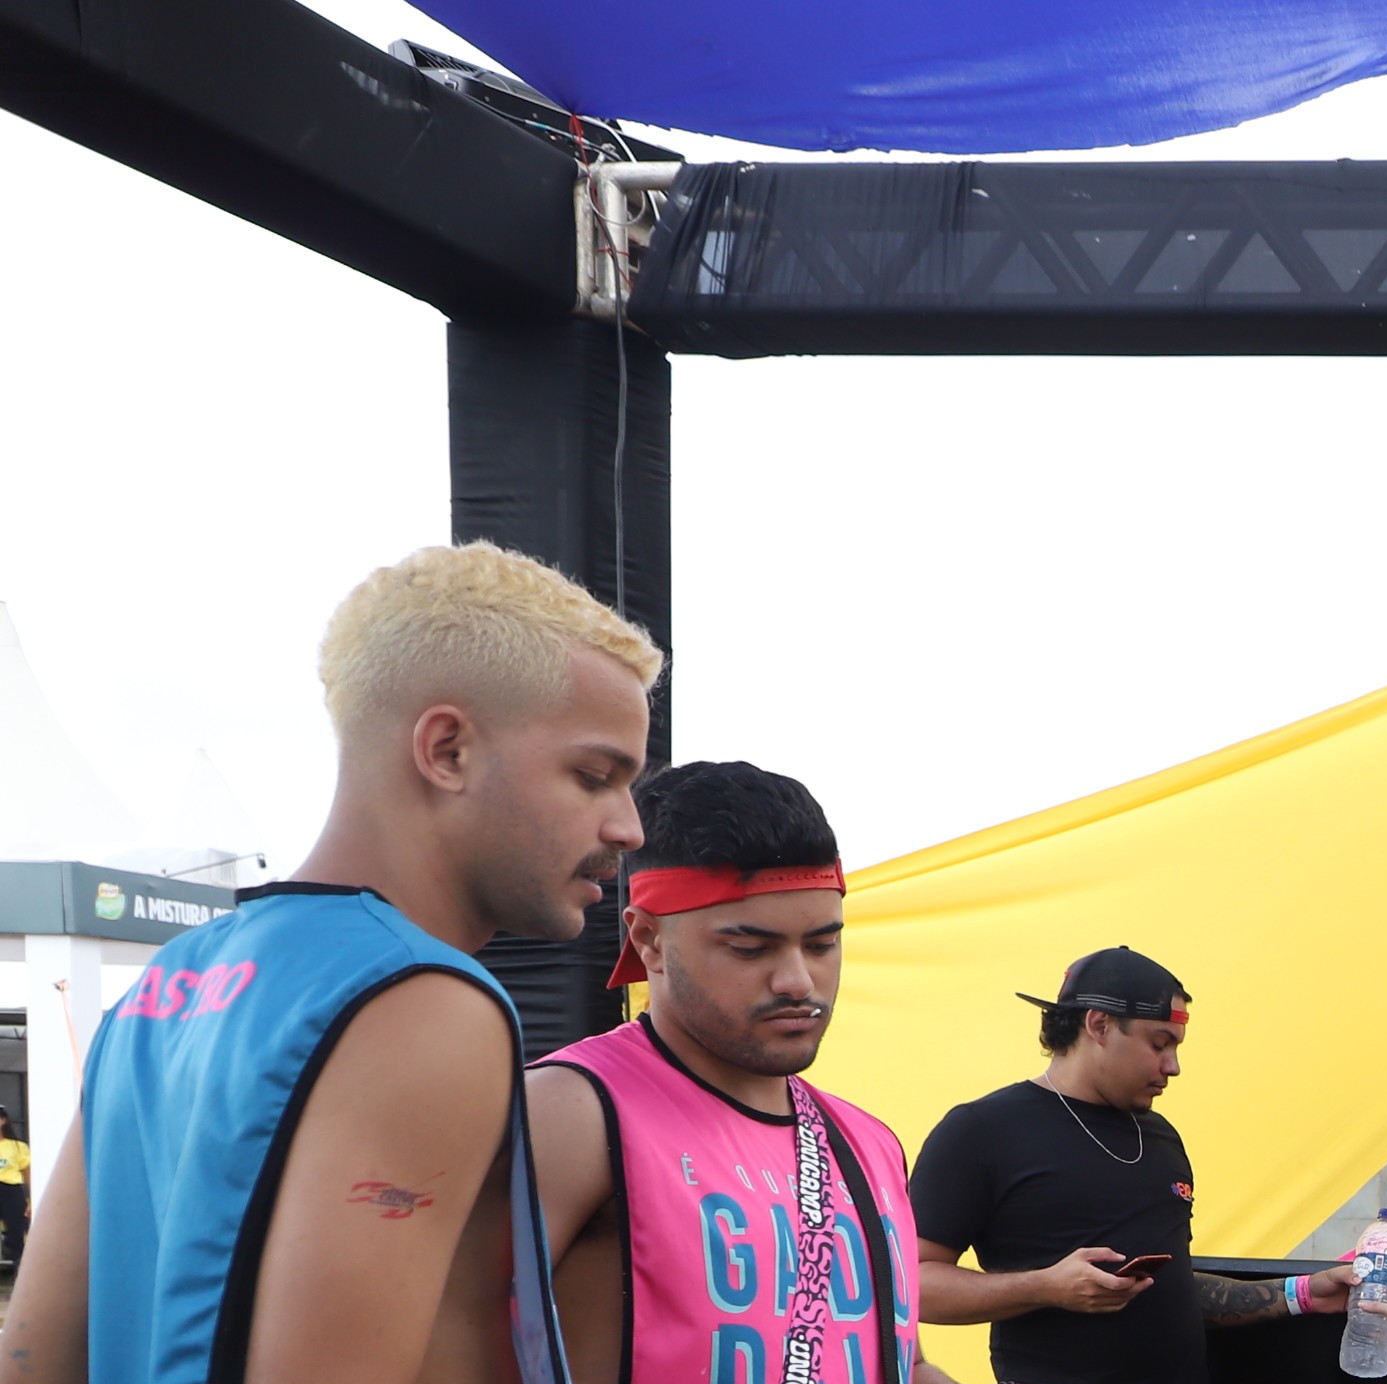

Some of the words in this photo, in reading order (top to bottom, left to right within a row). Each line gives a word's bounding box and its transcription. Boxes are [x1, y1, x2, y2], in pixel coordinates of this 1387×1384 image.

[134, 895, 147, 918] A
[149, 897, 208, 926] MISTURA
[680, 1152, 698, 1185] É
